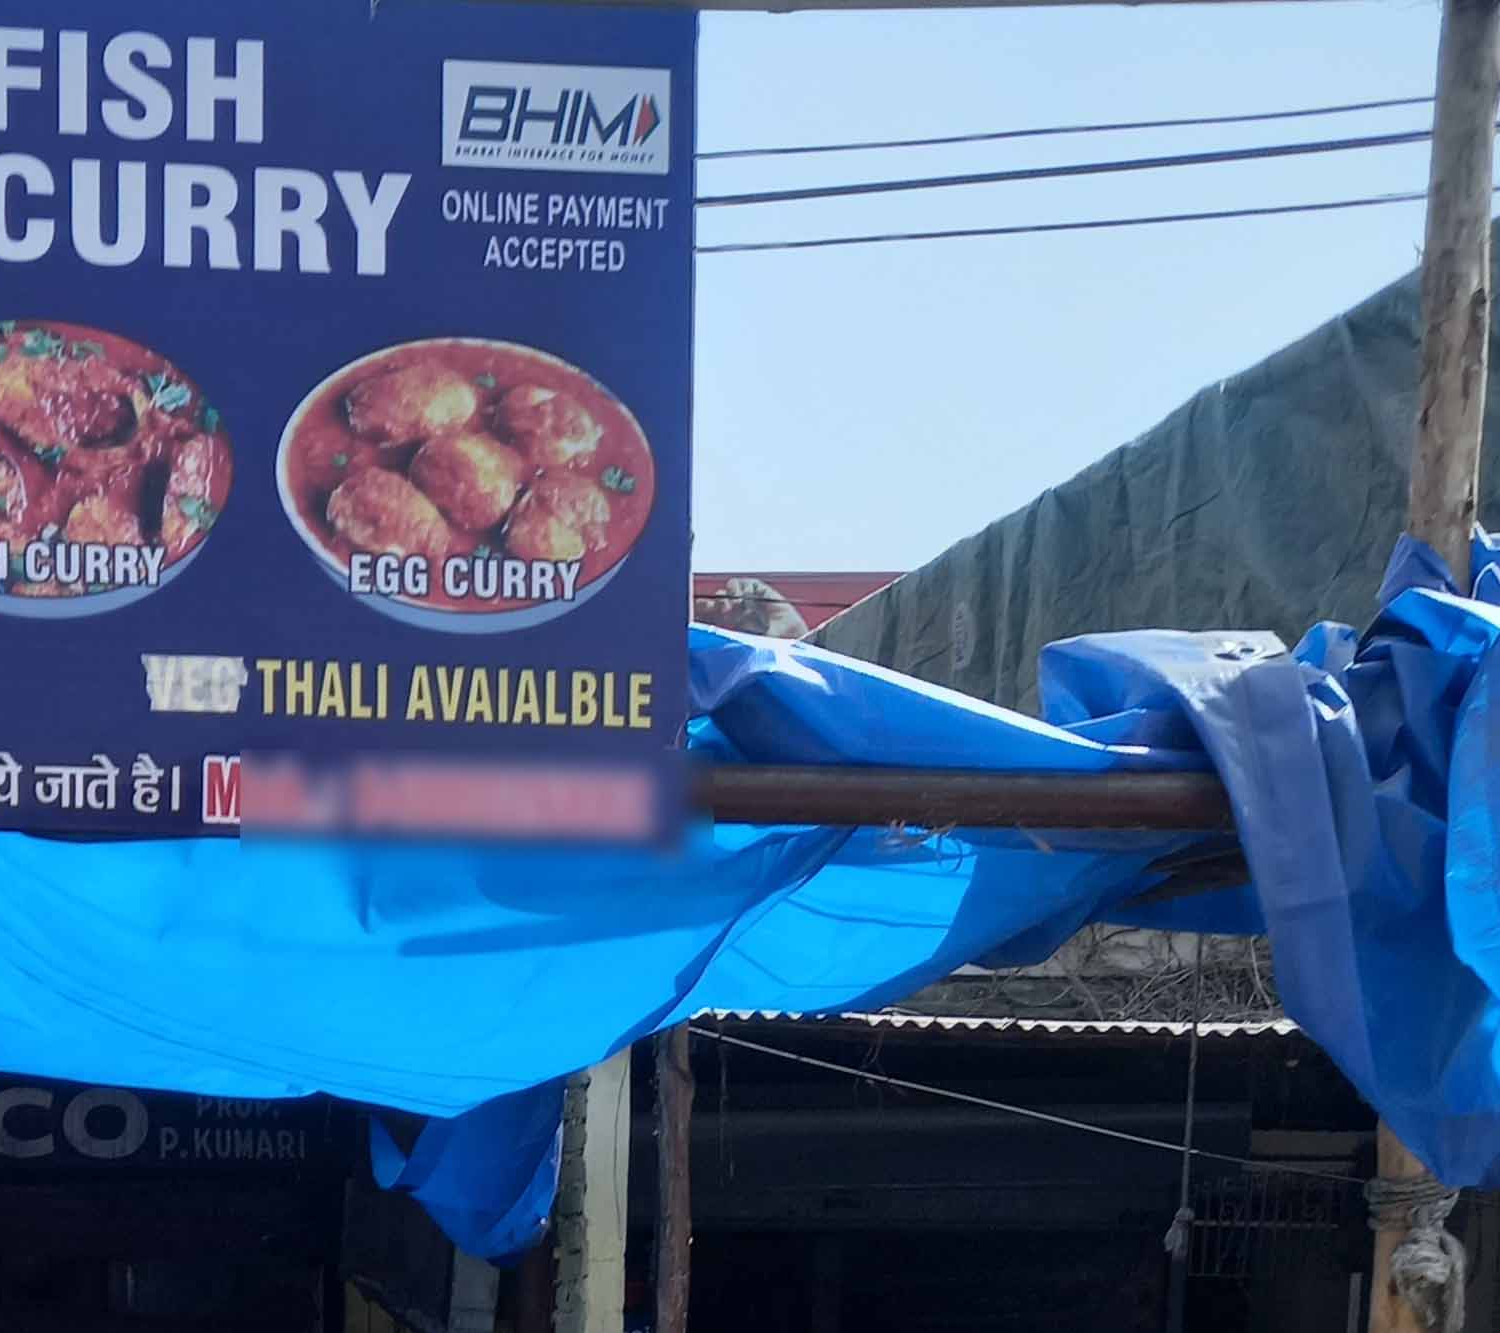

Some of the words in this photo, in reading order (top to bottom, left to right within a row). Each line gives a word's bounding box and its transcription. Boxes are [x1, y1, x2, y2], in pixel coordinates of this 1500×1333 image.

[458, 85, 638, 147] BHIM
[579, 150, 604, 162] FOR
[441, 189, 539, 225] ONLINE
[547, 194, 669, 231] PAYMENT
[483, 236, 626, 273] ACCEPTED
[25, 542, 166, 587] CURRY
[348, 552, 428, 597] EGG
[443, 554, 581, 600] CURRY
[255, 657, 389, 719] THALI
[405, 664, 653, 729] AVAIALBLE
[34, 753, 120, 810] जाते
